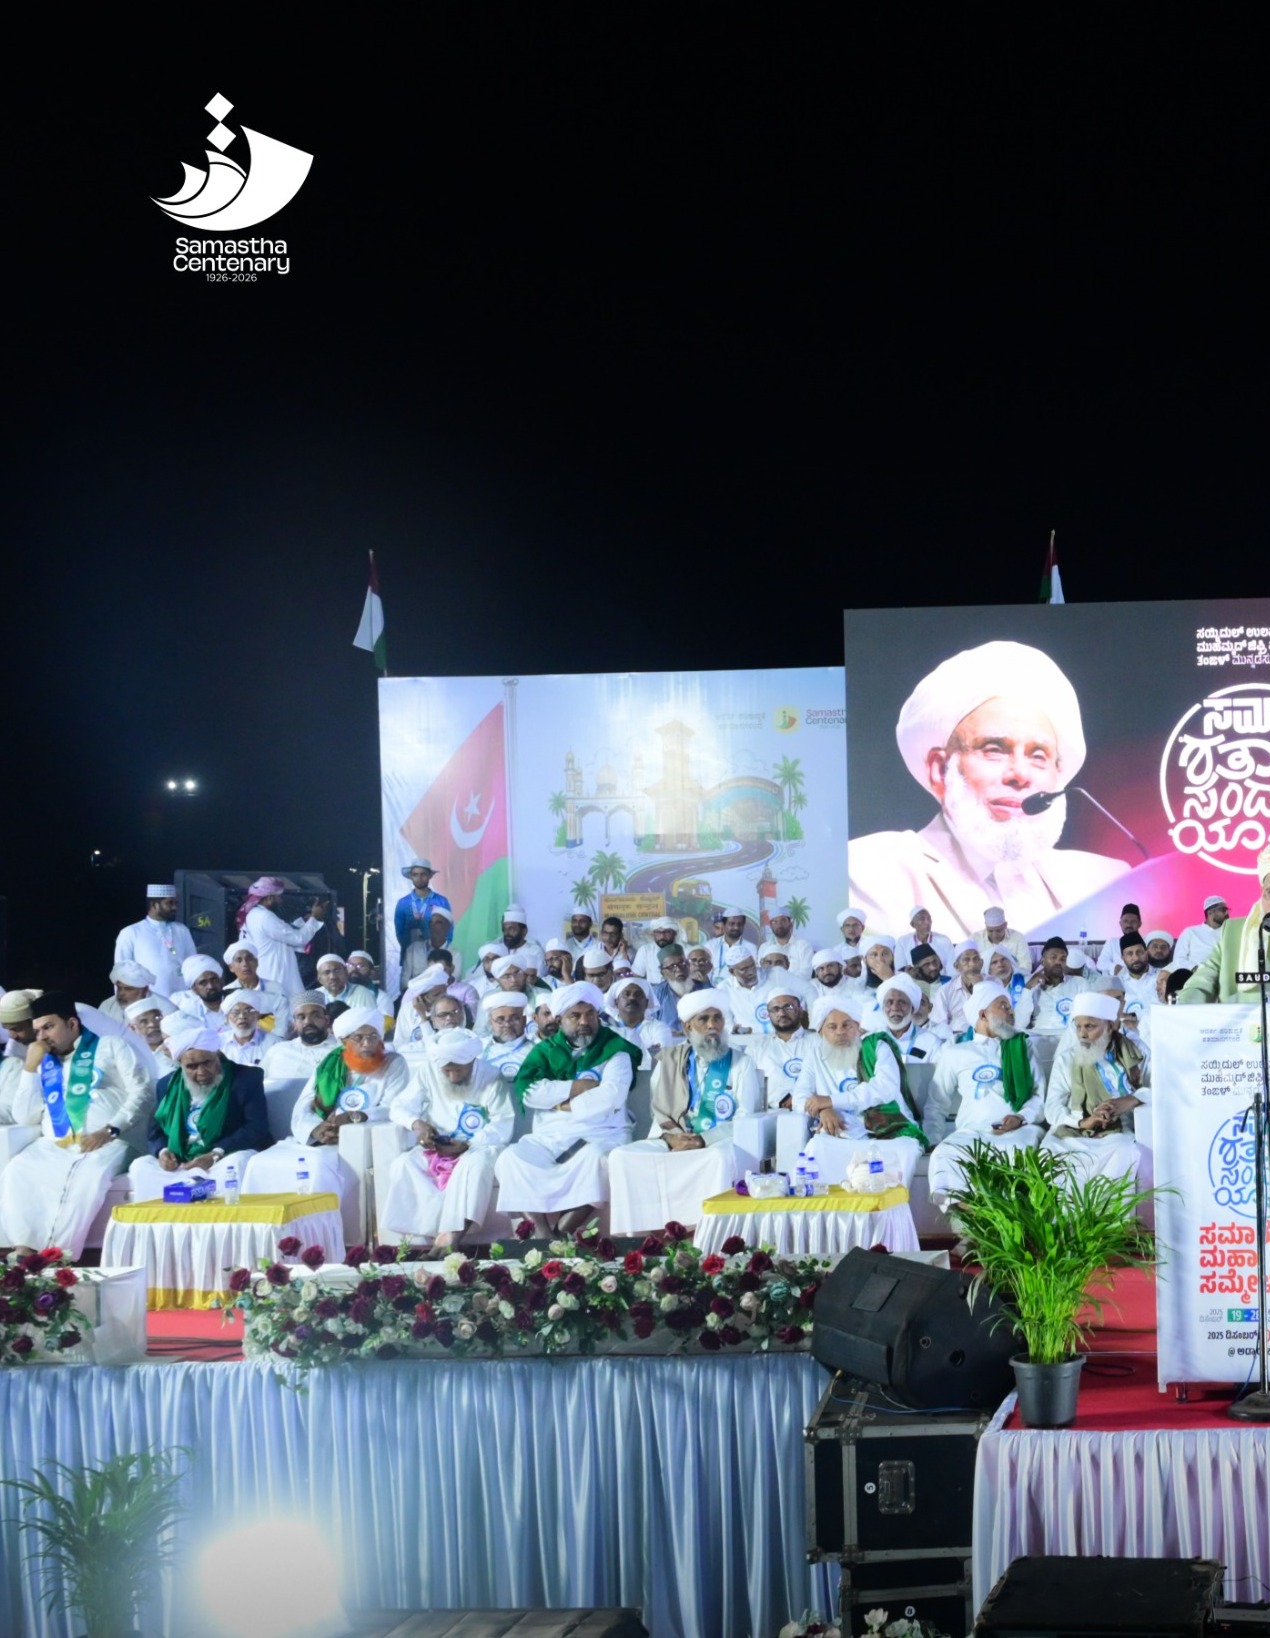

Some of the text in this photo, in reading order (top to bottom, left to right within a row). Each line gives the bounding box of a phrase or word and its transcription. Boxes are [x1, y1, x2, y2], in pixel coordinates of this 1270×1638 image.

[1200, 1245, 1259, 1268] ಮಹಾ
[1232, 1311, 1241, 1320] 19
[1208, 1331, 1223, 1339] 2025
